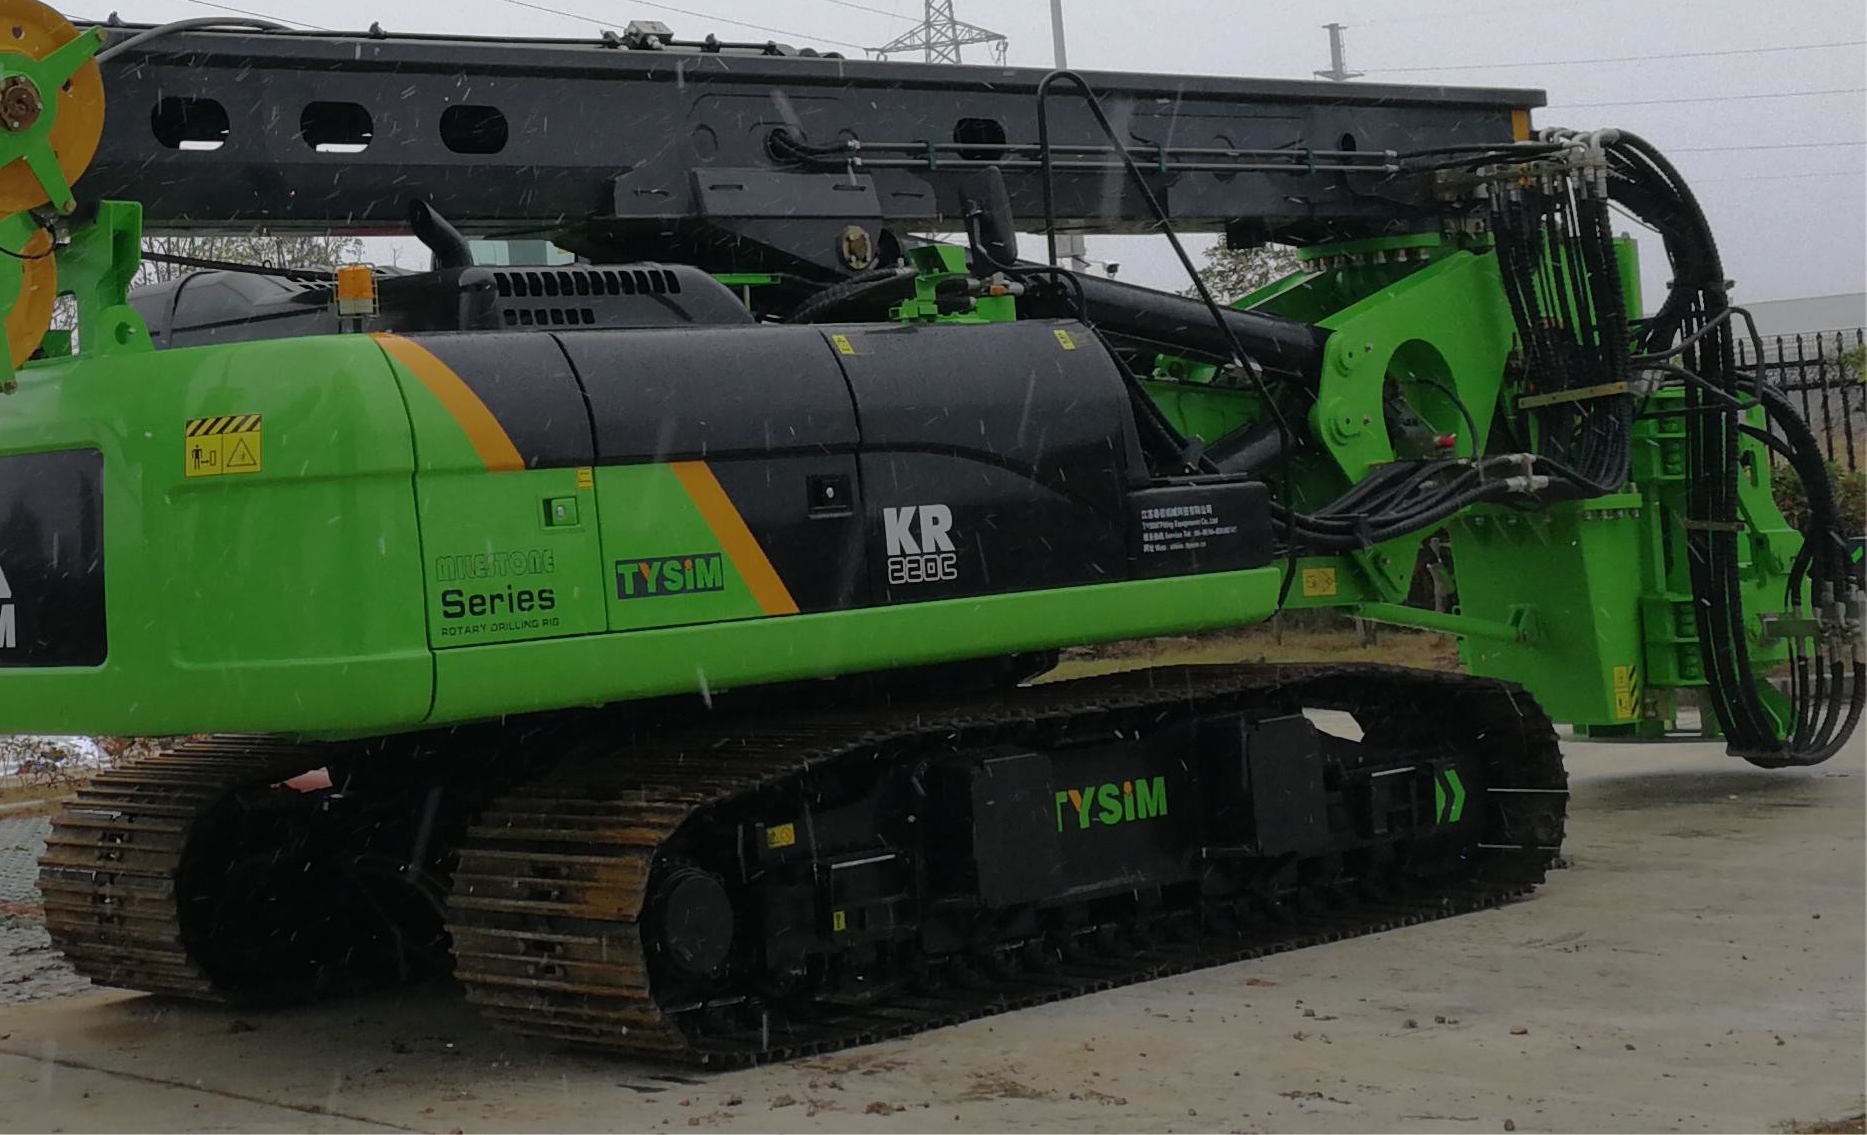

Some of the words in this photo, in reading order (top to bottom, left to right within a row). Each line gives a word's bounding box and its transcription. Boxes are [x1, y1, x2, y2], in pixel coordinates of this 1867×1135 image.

[883, 504, 956, 555] KR
[887, 553, 958, 584] 220C
[441, 584, 556, 619] Series
[441, 623, 486, 637] ROTARY
[490, 619, 539, 633] DRILLING
[542, 617, 560, 627] RIG
